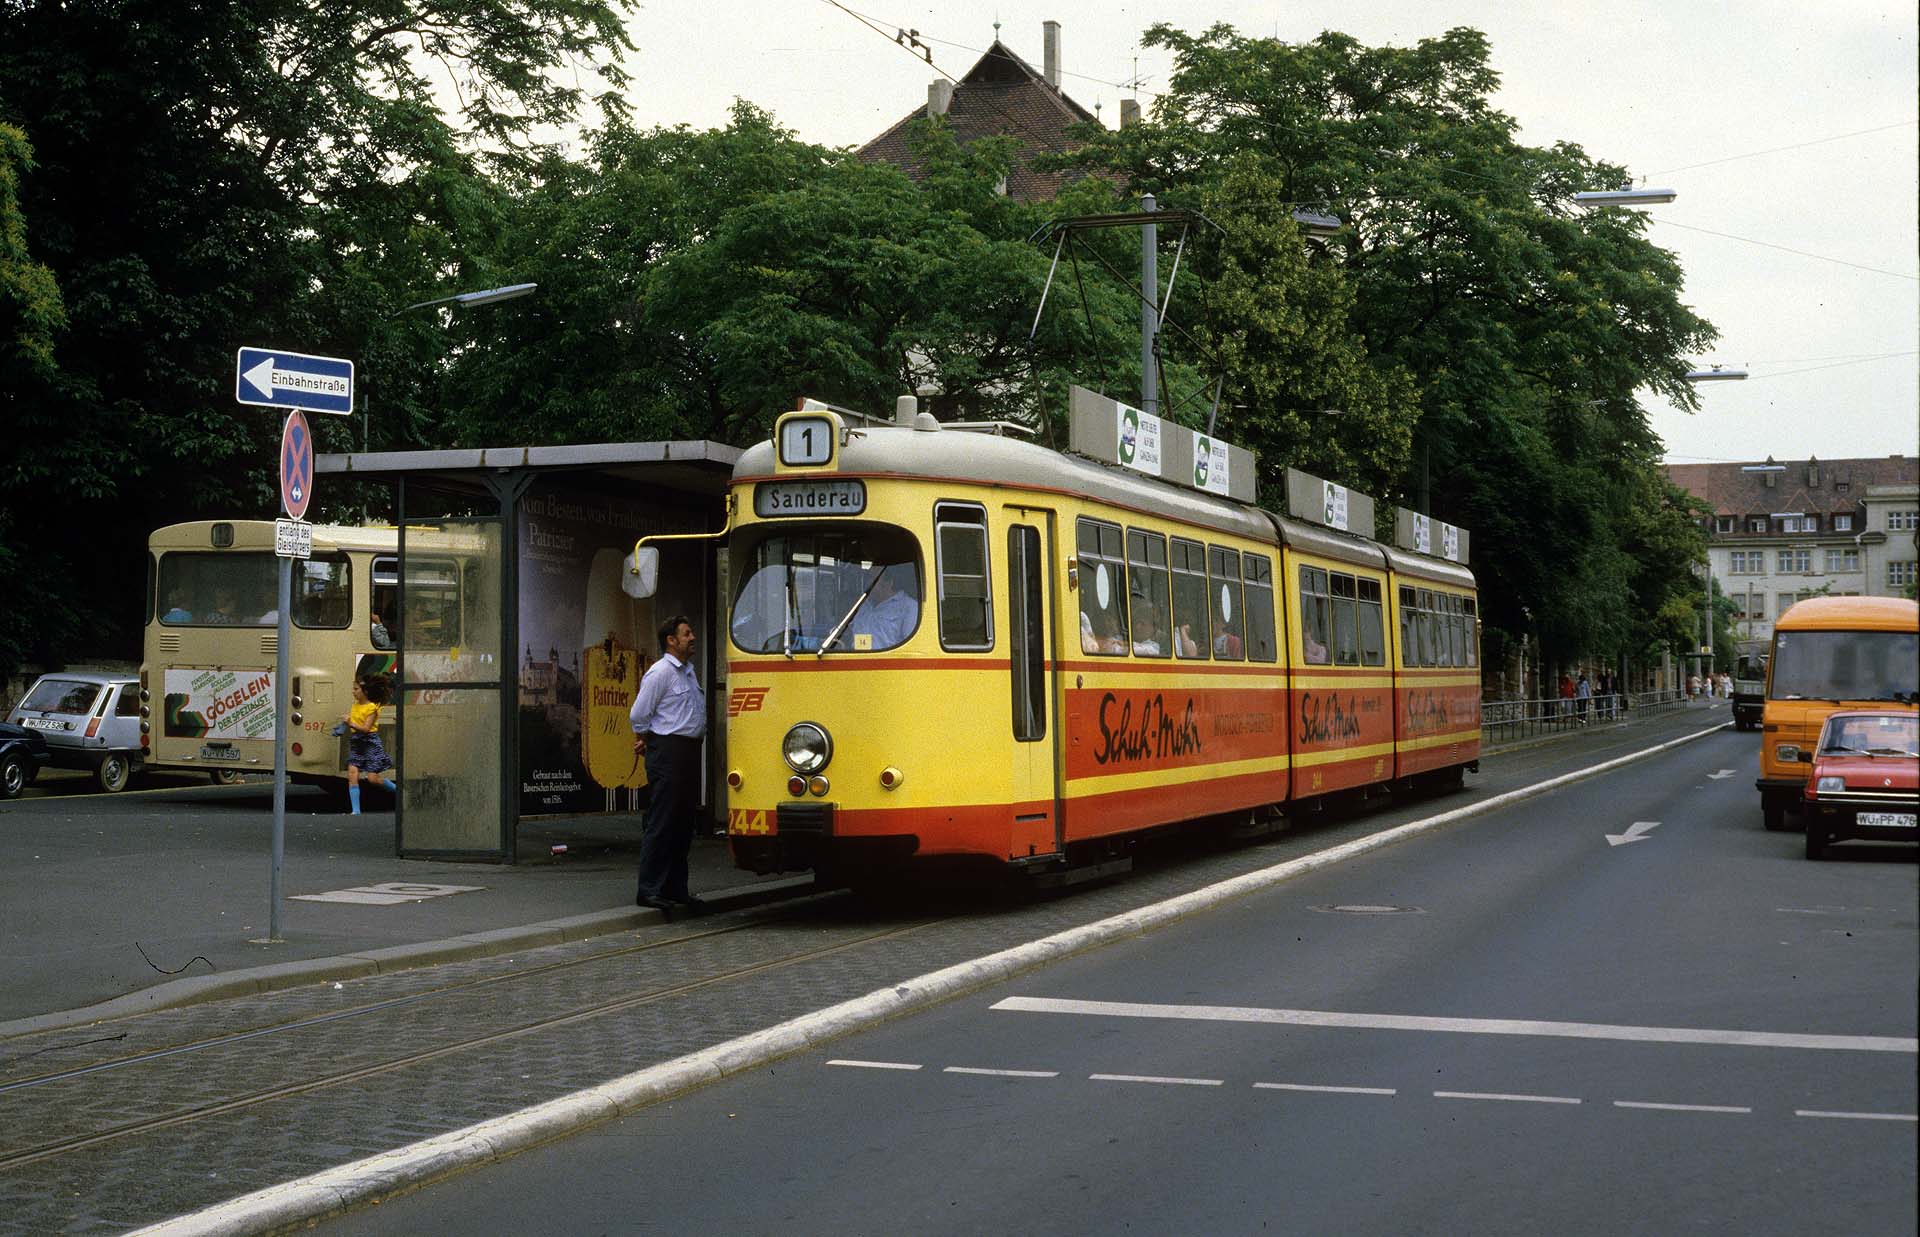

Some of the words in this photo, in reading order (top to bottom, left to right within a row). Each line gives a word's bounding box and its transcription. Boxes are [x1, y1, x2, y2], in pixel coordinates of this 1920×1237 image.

[271, 373, 346, 393] Einbahnstraße
[802, 428, 812, 457] 1
[770, 489, 861, 509] Sanderau
[206, 674, 271, 720] GÖGELEIN
[594, 686, 629, 708] Patrizier
[217, 716, 232, 730] DER
[304, 721, 326, 733] 597
